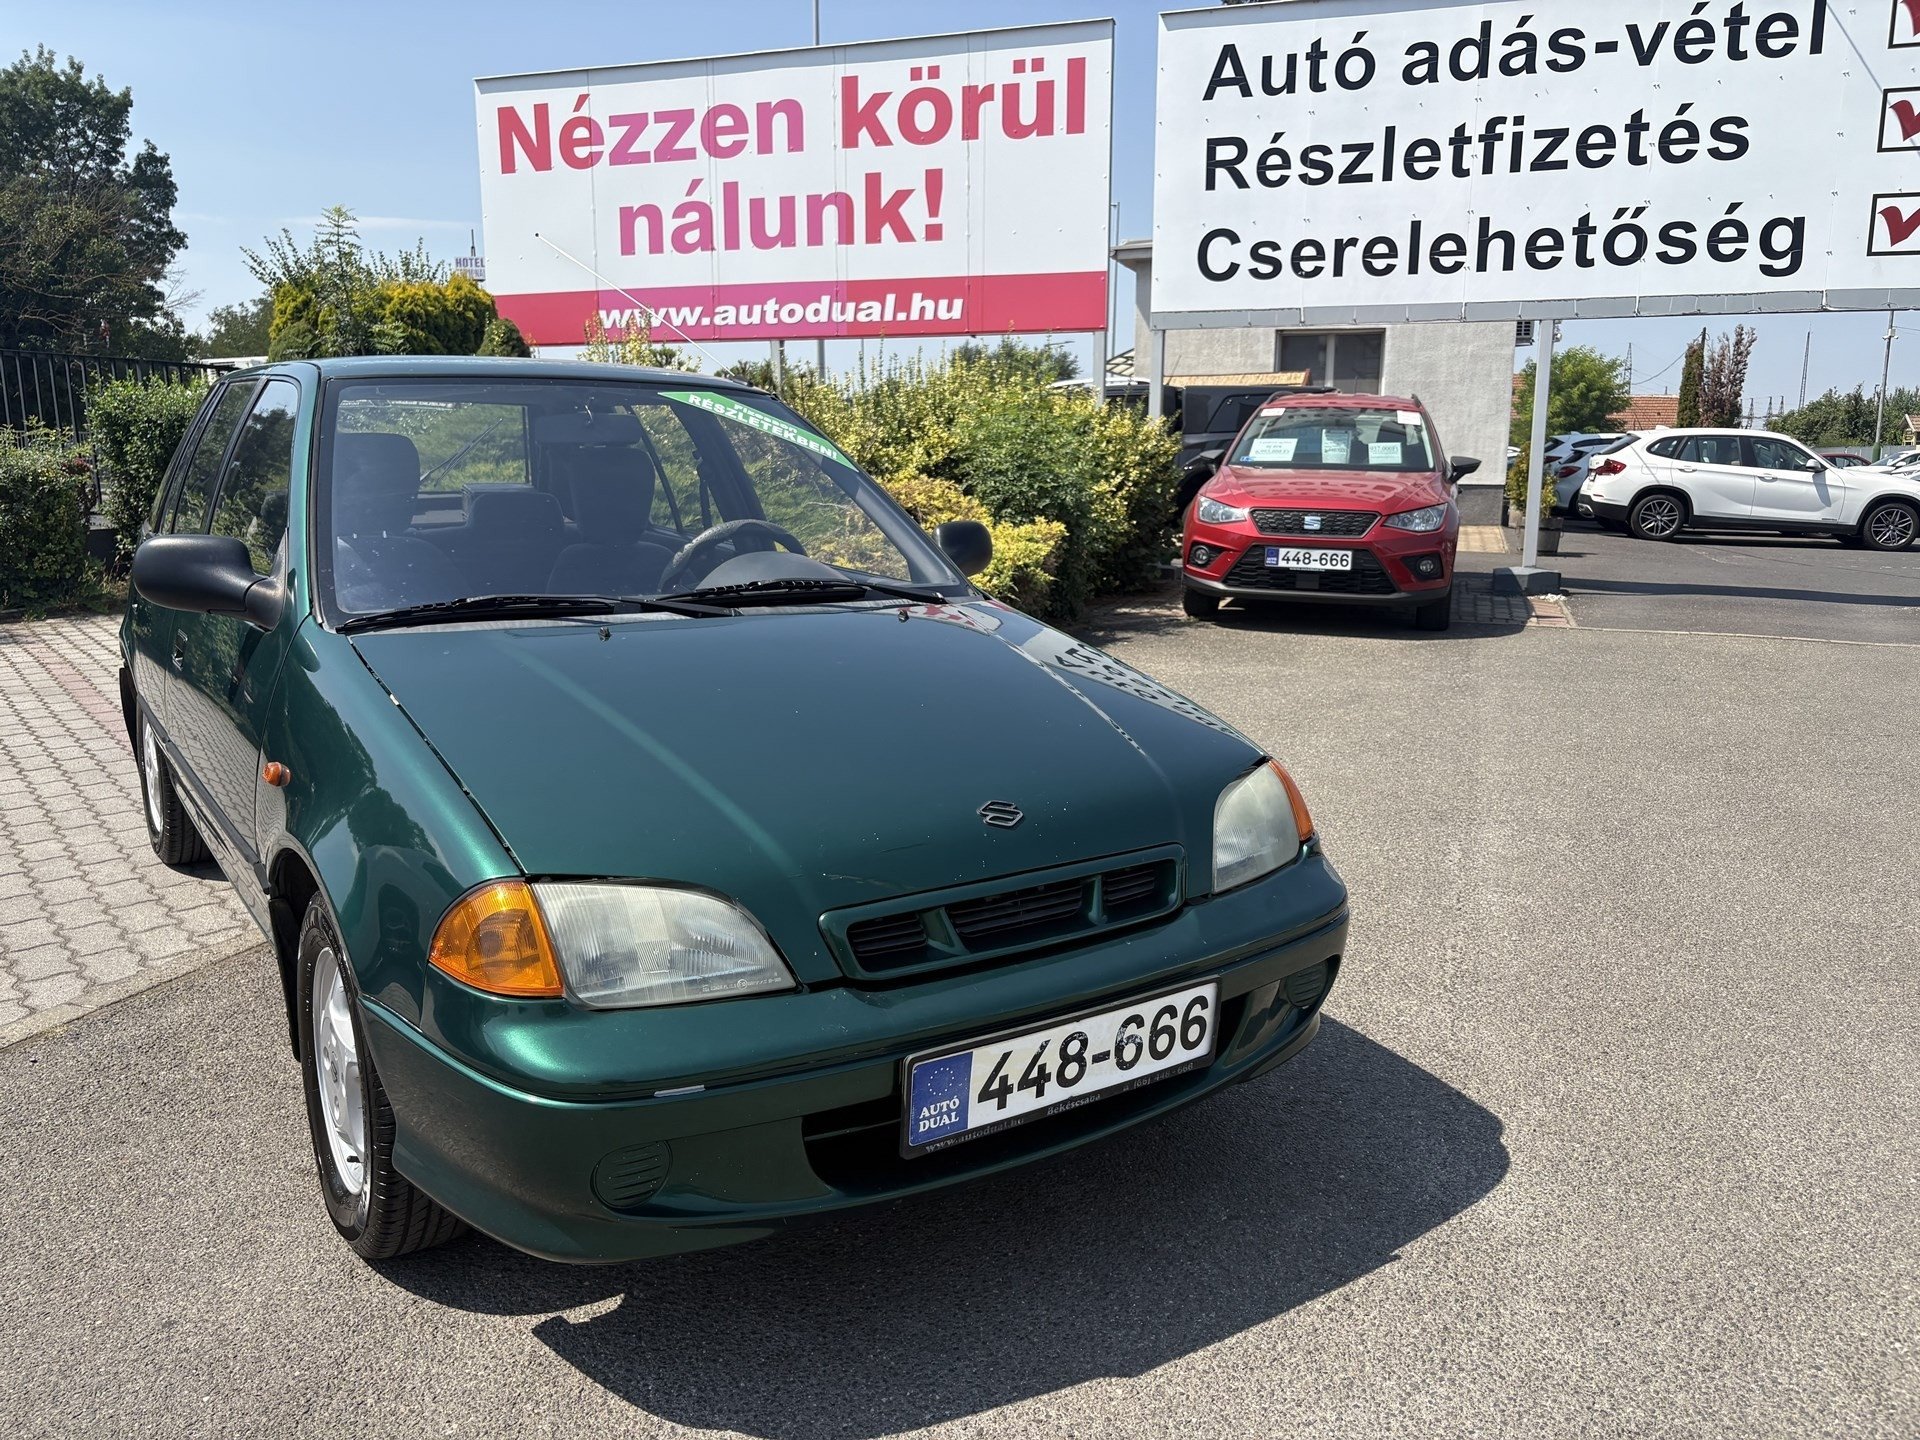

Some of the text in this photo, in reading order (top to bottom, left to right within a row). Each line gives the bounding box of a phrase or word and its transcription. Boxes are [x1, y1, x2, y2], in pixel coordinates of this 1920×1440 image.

[1203, 0, 1826, 101] Autó adás-vétel
[497, 57, 1086, 174] Nézzen körül
[1203, 102, 1750, 191] Részletfizetés
[619, 168, 943, 256] nálunk!
[1197, 202, 1806, 282] Cserelehetőség
[455, 257, 485, 268] HOTEL
[599, 293, 964, 329] www.autodual.hu
[1281, 550, 1349, 567] 448-666
[977, 995, 1209, 1111] 448-666
[919, 1095, 960, 1119] AUTÓ
[919, 1111, 960, 1132] DUAL
